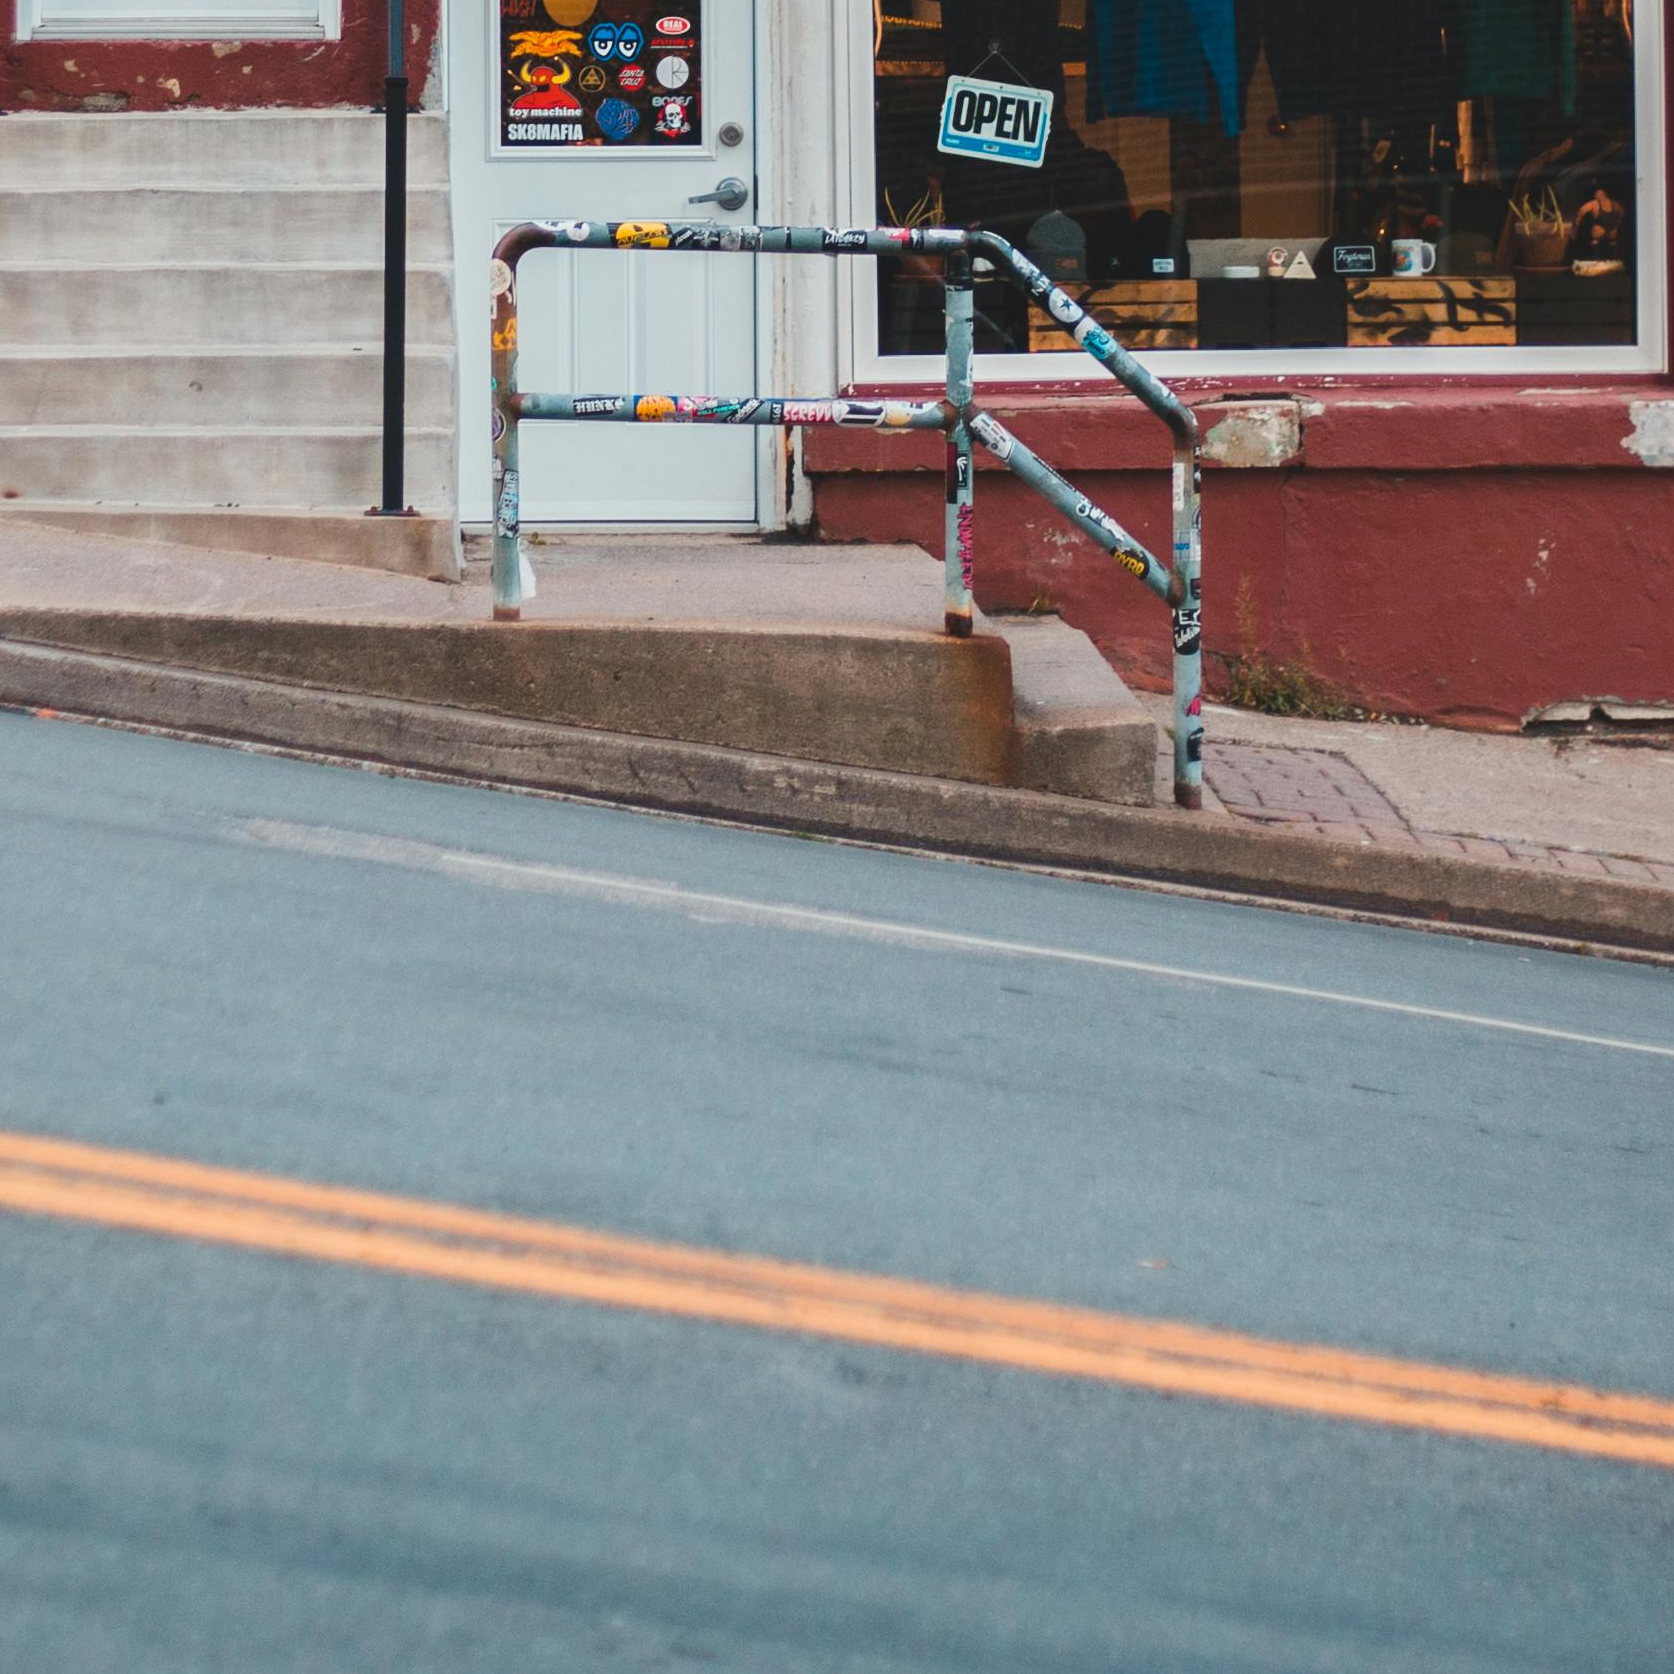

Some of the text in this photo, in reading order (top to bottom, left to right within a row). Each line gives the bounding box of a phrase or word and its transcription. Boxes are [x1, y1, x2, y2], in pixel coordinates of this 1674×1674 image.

[509, 106, 583, 118] toy machine
[952, 89, 1042, 143] OPEN
[507, 123, 584, 141] SK8MAFIA
